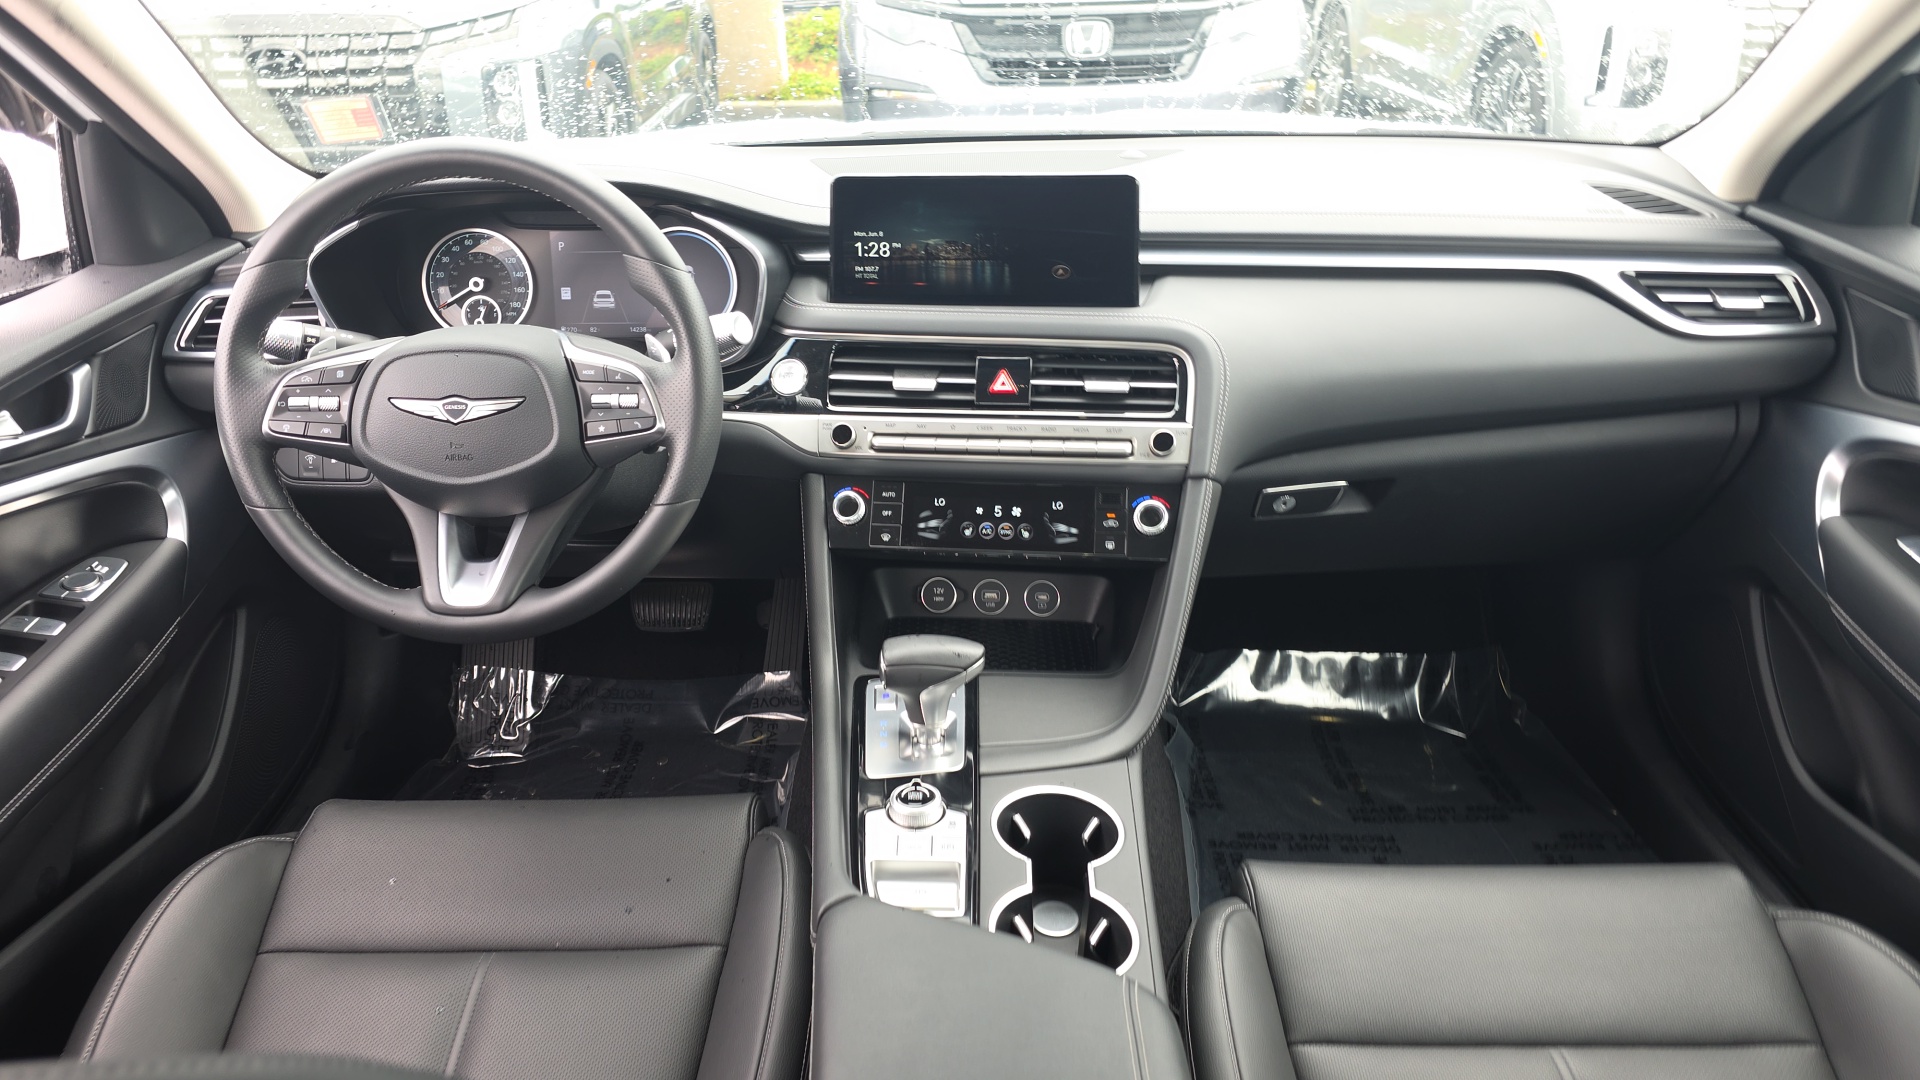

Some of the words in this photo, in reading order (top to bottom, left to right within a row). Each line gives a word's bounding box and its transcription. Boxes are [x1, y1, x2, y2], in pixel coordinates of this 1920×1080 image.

[558, 241, 565, 251] P
[854, 241, 891, 258] 1:28
[513, 286, 526, 294] 160
[444, 453, 474, 462] AIRBAG
[934, 497, 946, 507] LO
[1051, 500, 1064, 511] LO
[993, 505, 1003, 518] 5
[933, 587, 945, 595] 12V
[751, 695, 800, 710] EMOVE
[599, 702, 653, 714] DEALER
